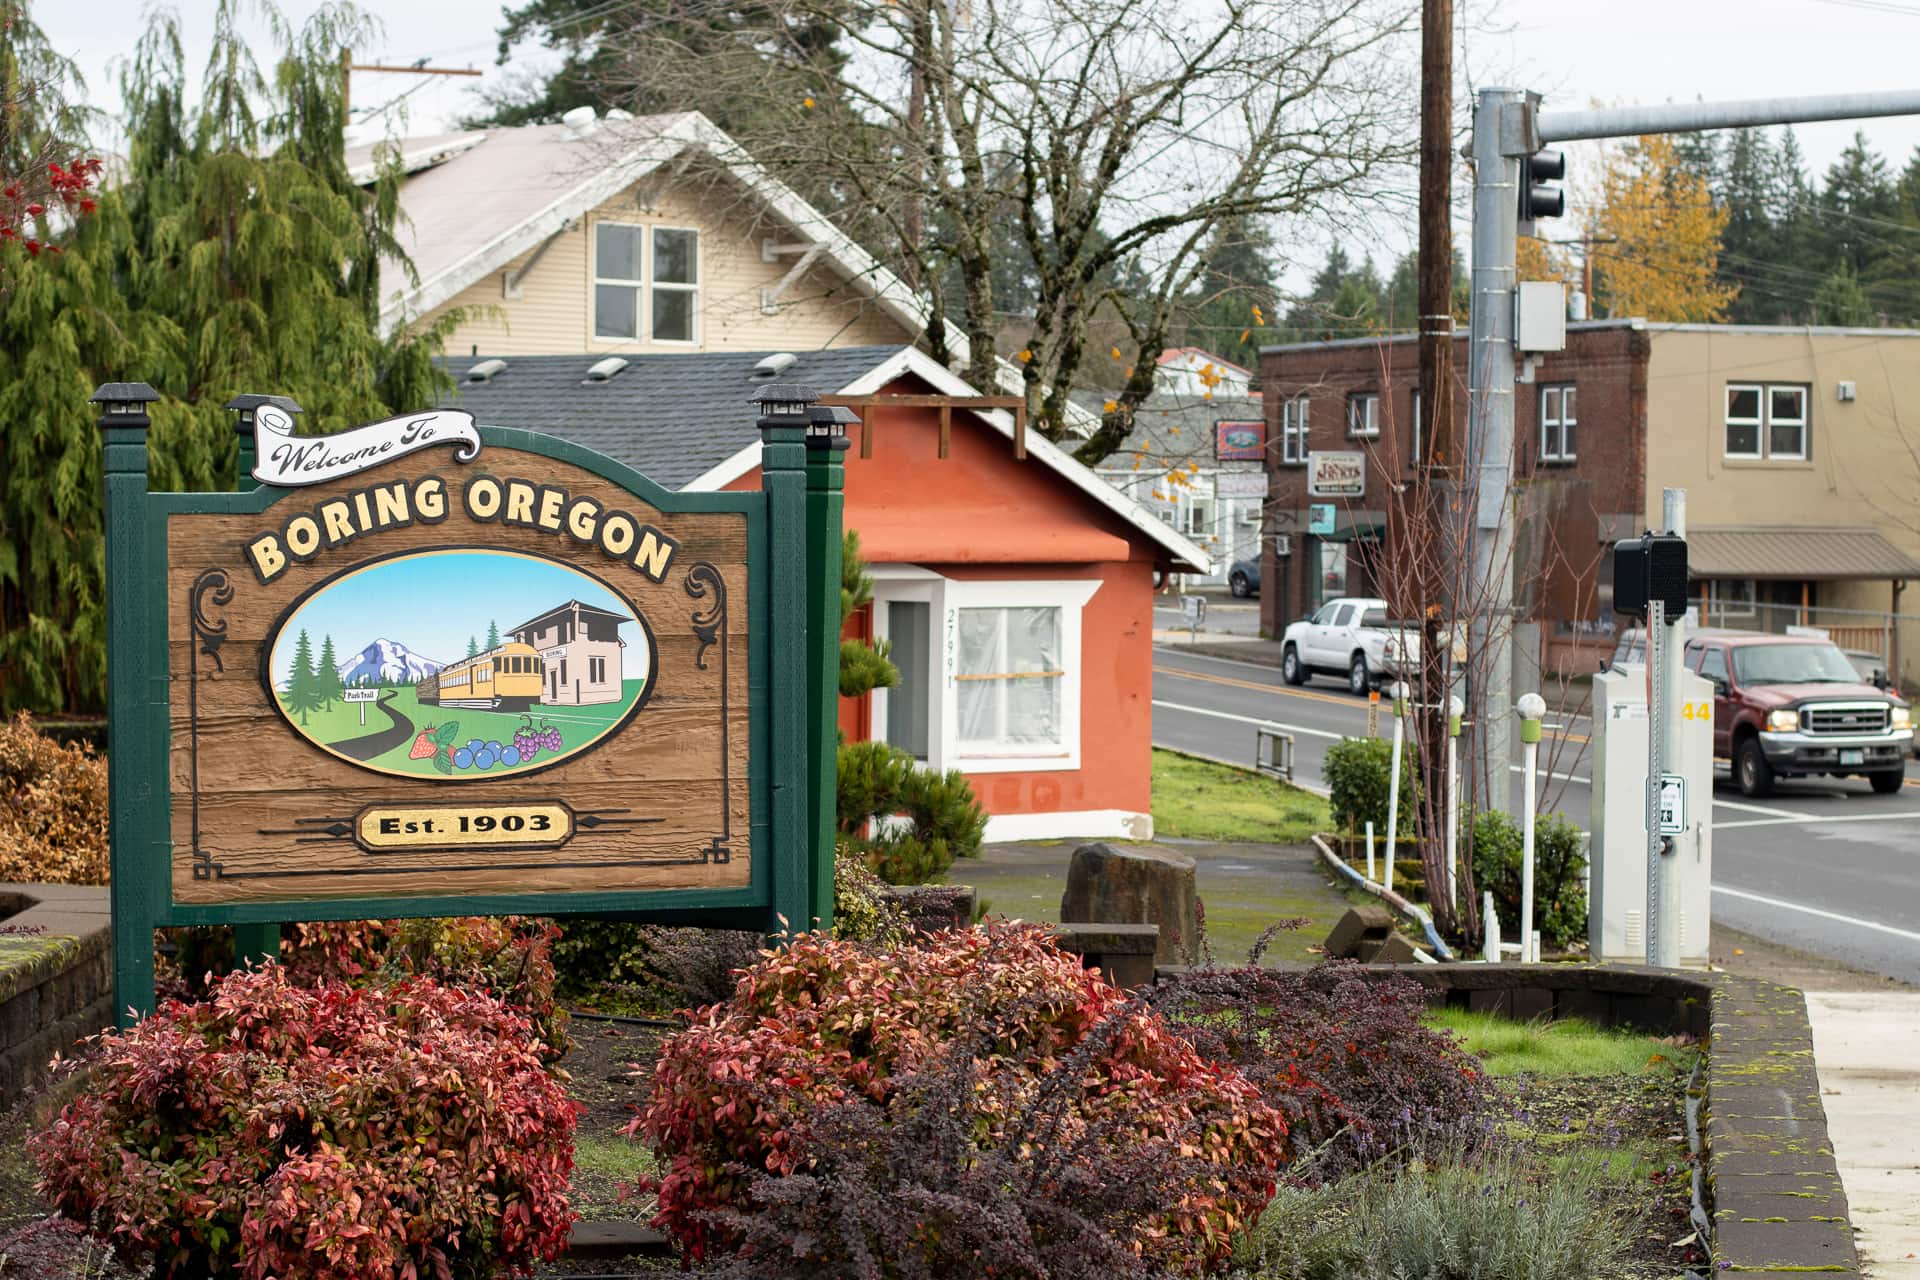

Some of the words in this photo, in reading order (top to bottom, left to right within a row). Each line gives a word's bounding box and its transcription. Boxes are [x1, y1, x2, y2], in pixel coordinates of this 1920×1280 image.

[270, 441, 393, 476] Welcome
[400, 415, 439, 445] To
[249, 478, 445, 580] BORING
[467, 478, 673, 580] OREGON
[361, 691, 374, 699] Trail
[1681, 702, 1711, 721] 44
[379, 817, 445, 835] Est.
[458, 814, 551, 833] 1903
